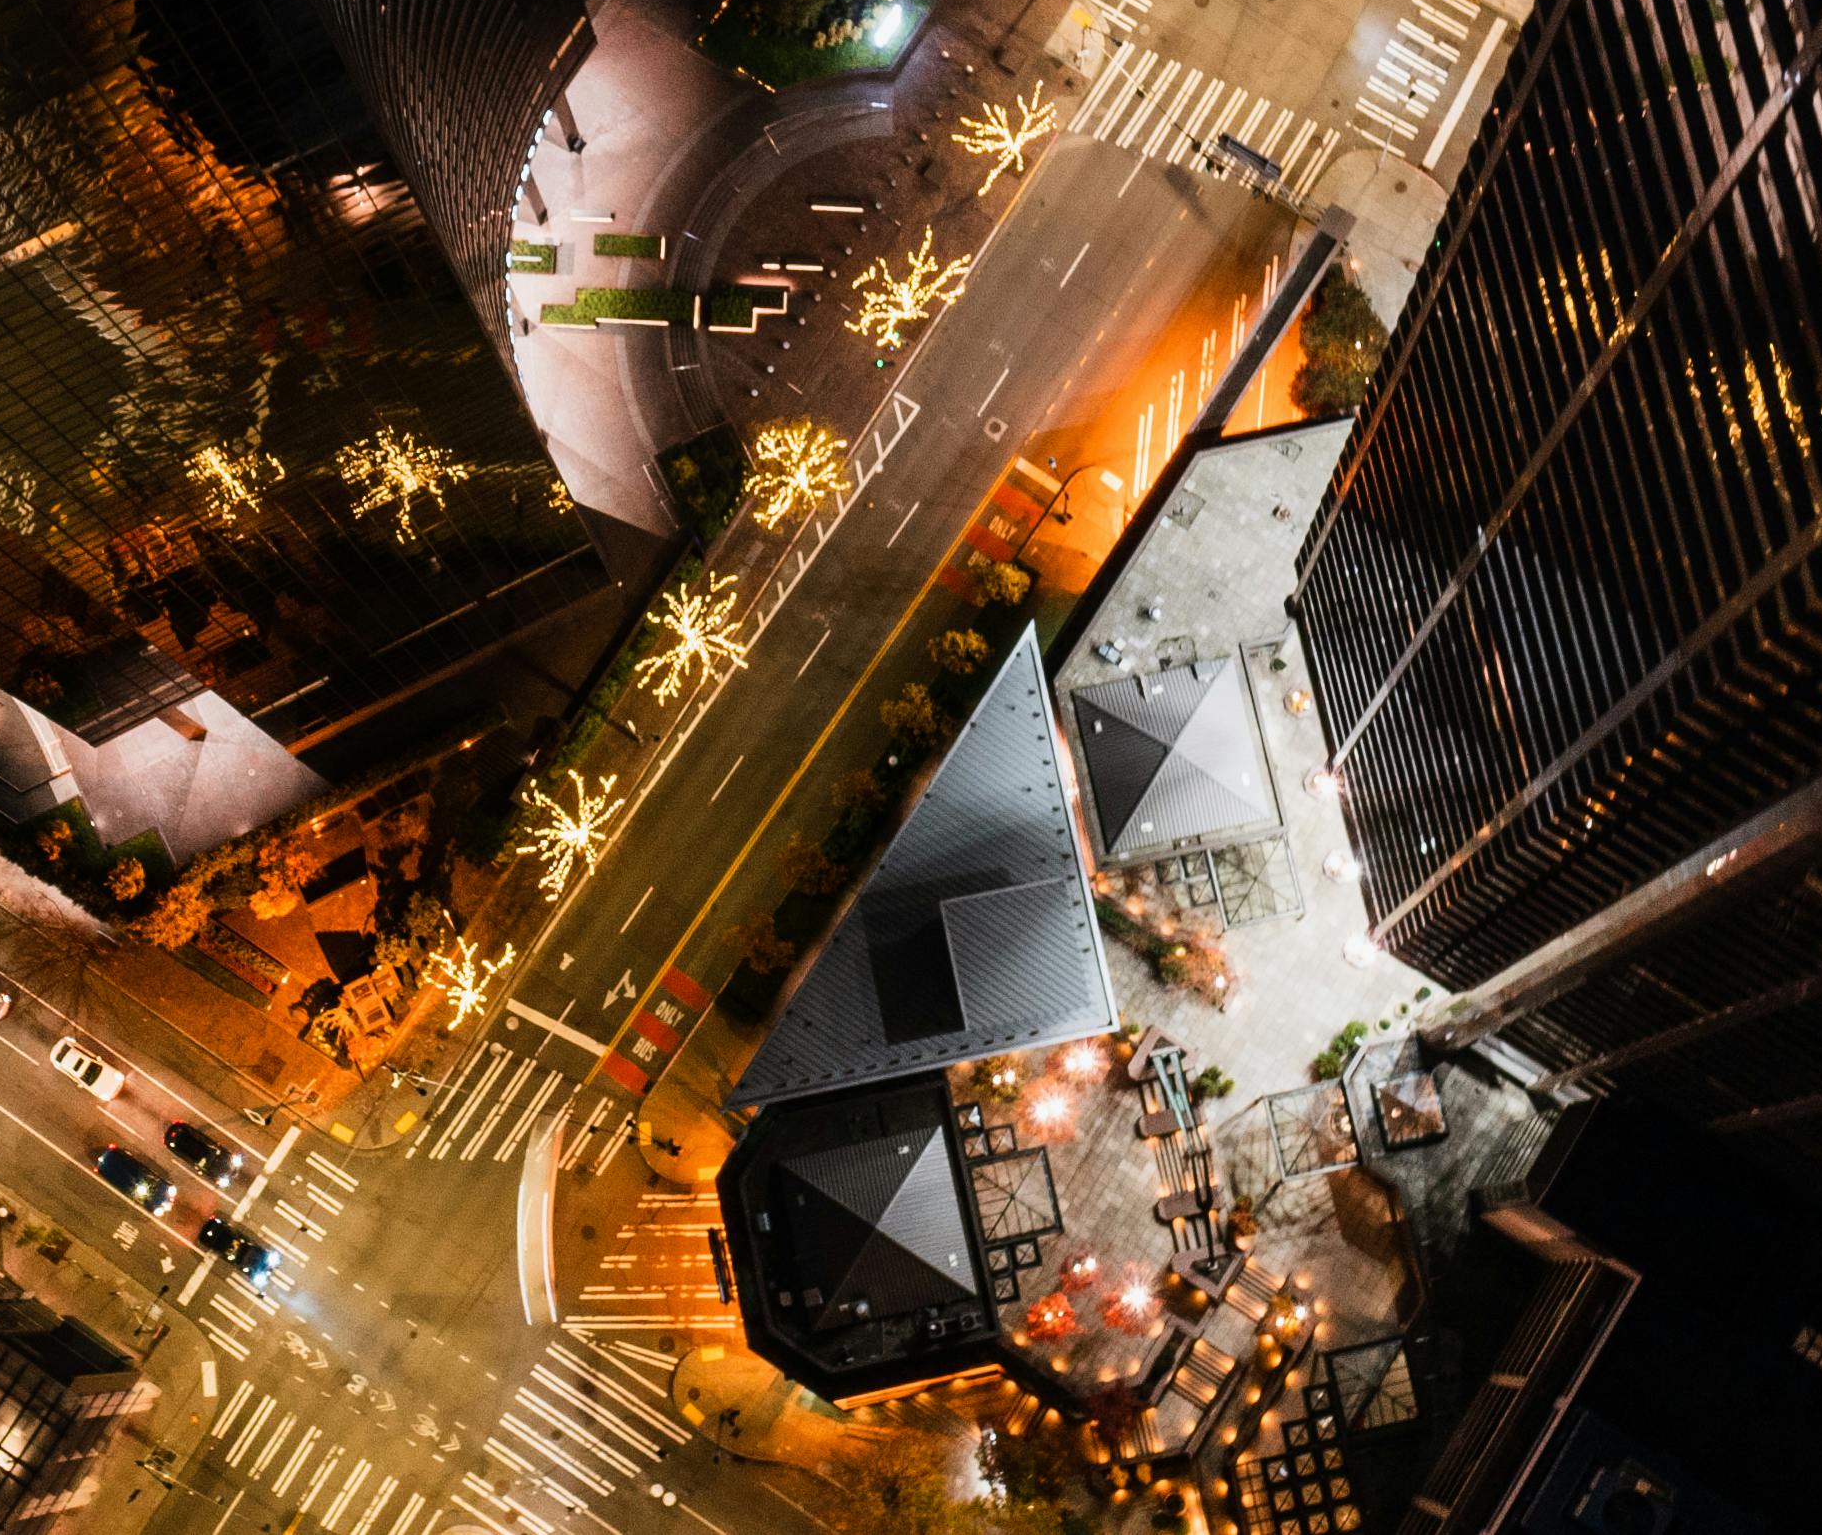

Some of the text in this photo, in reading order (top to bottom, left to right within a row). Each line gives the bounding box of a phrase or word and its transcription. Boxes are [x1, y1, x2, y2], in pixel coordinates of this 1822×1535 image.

[988, 515, 1018, 541] ONLY
[655, 1000, 685, 1027] ONLY
[632, 1037, 657, 1062] BUS
